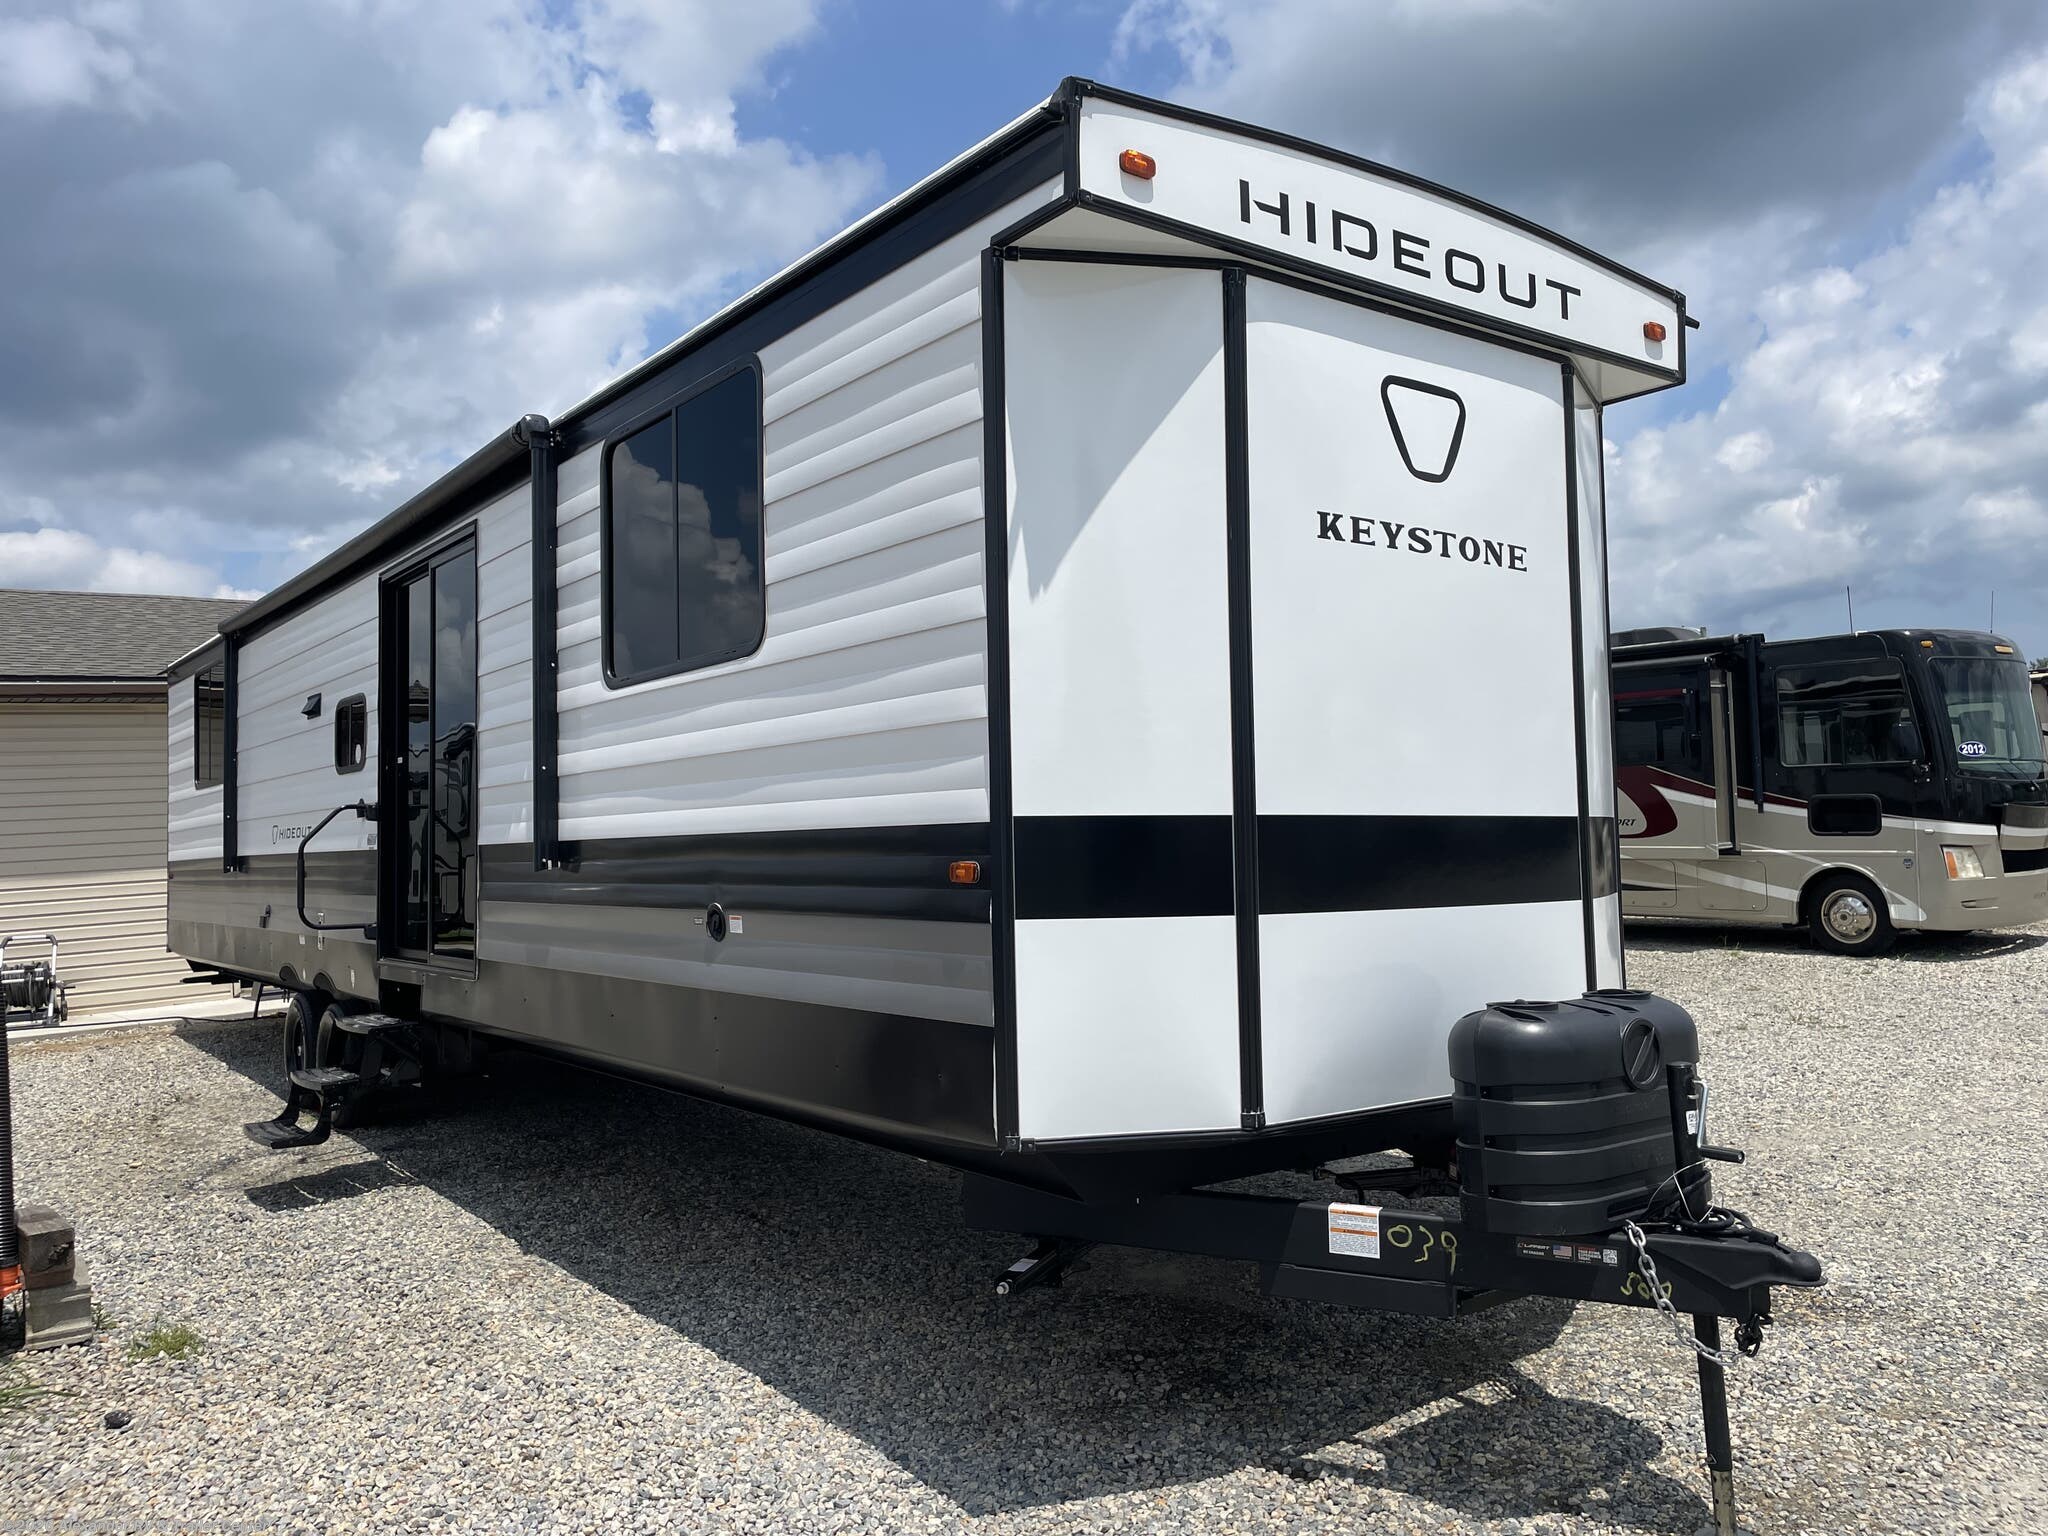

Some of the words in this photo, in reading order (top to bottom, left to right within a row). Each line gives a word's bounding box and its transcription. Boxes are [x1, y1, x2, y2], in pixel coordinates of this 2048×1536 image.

[1239, 178, 1581, 321] HIDEOUT
[1316, 510, 1528, 573] KEYSTONE
[1961, 743, 1984, 754] 2012
[279, 825, 312, 840] HIDEOUT
